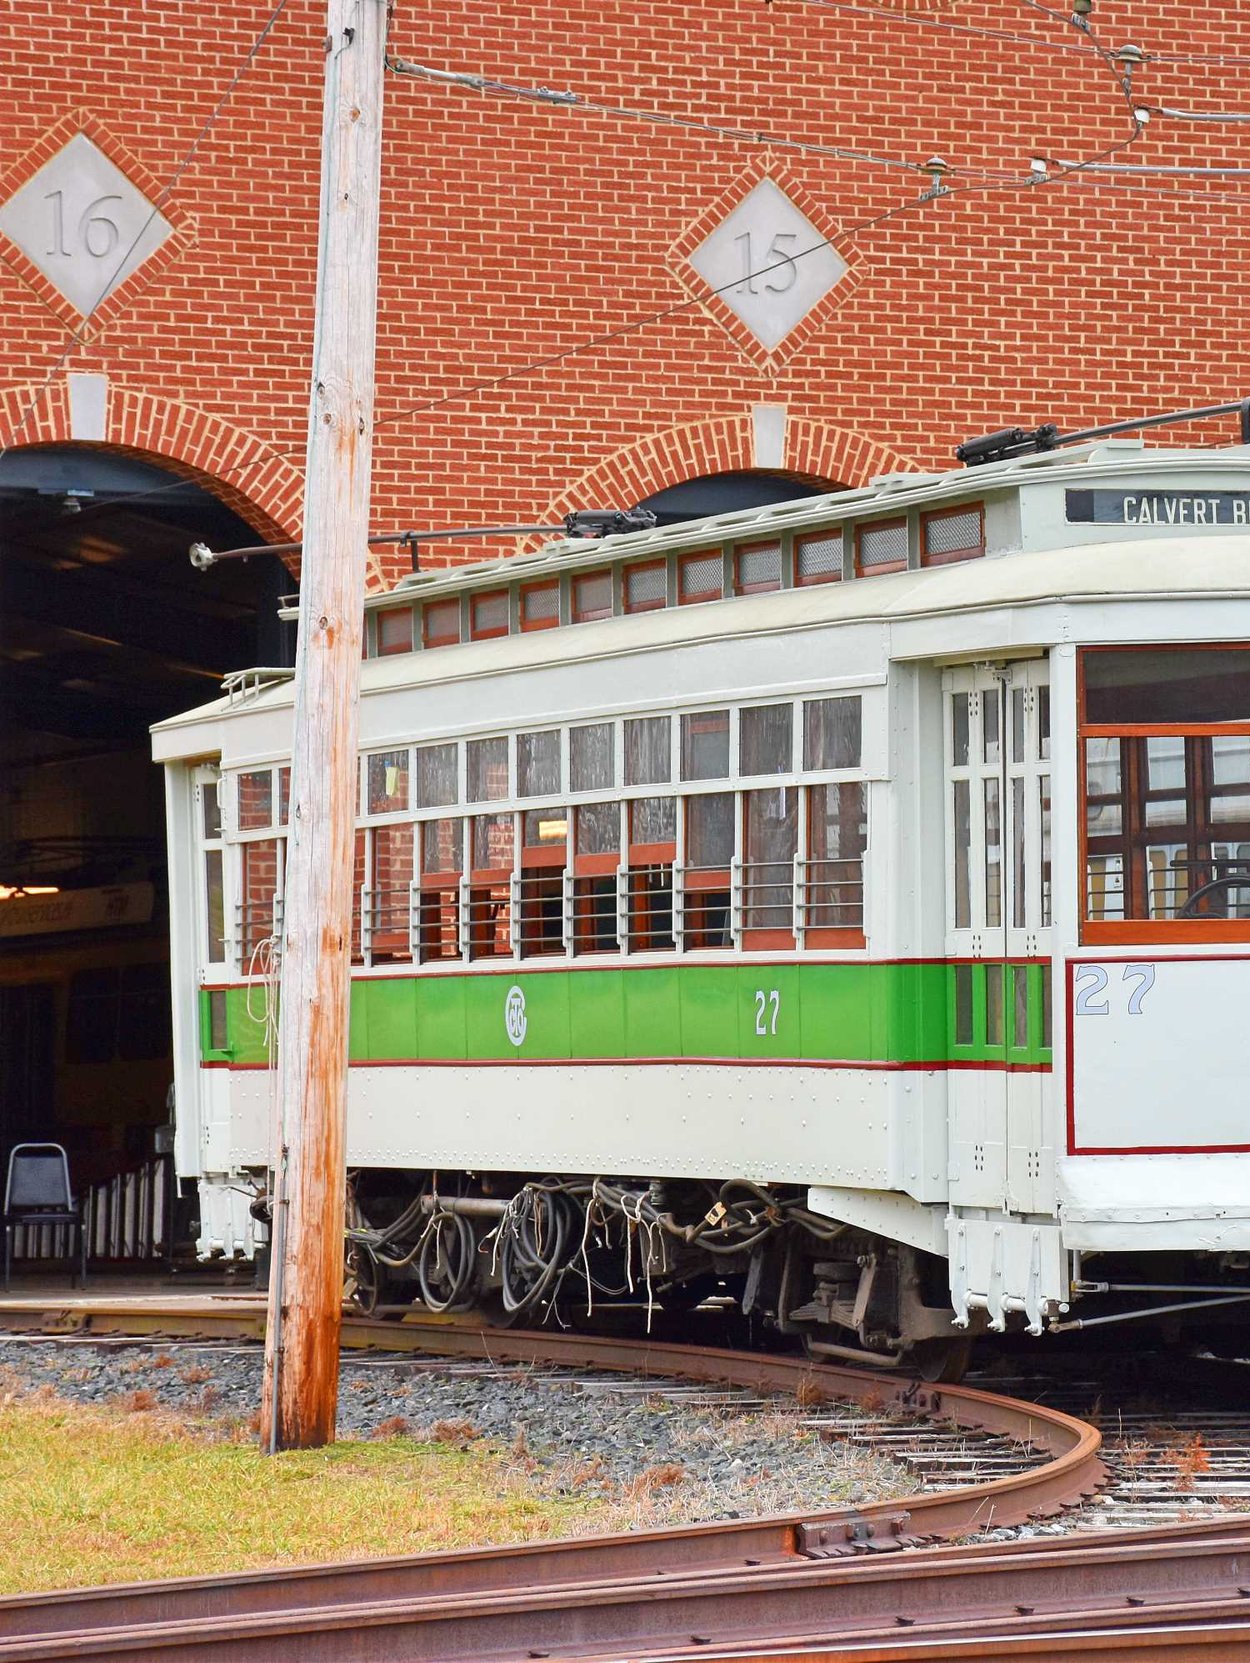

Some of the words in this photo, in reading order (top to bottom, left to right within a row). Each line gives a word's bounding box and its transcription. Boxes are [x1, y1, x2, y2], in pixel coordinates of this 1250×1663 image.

[43, 189, 123, 258] 16
[734, 231, 797, 295] 15
[1122, 496, 1220, 524] CALVERT
[755, 990, 780, 1035] 27
[1075, 964, 1155, 1016] 27
